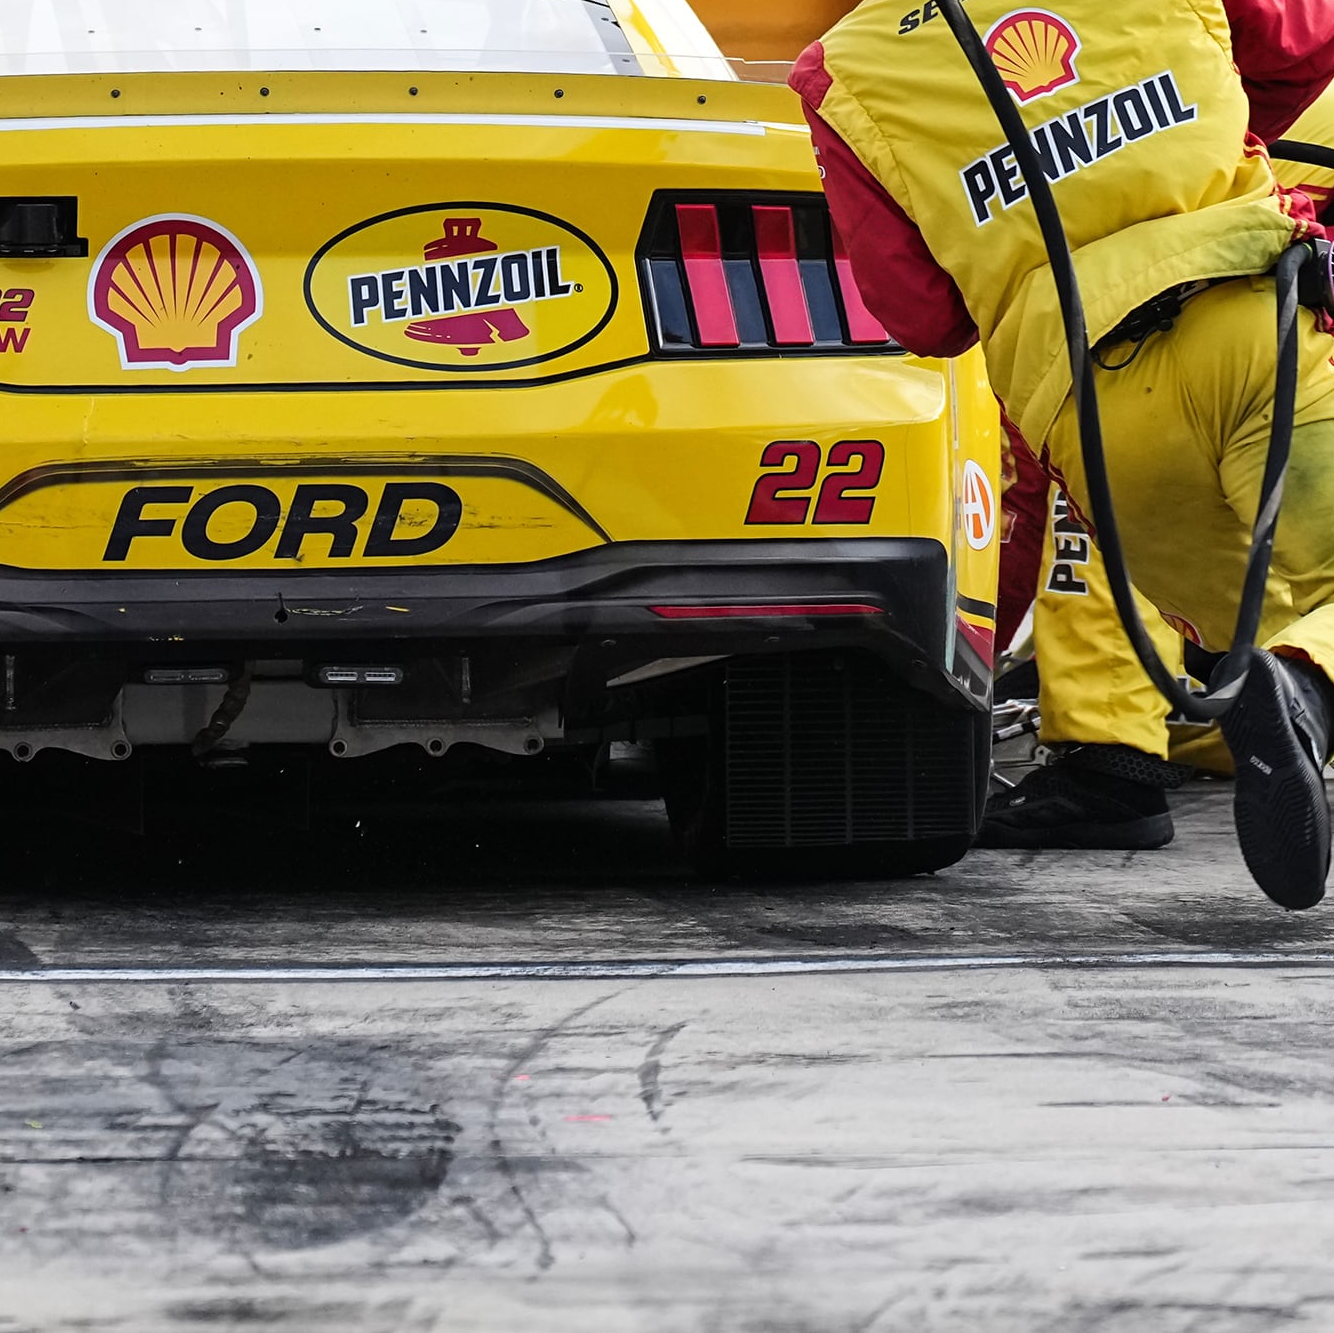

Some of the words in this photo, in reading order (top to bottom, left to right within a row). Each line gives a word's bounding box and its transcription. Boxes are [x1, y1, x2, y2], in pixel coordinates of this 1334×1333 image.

[964, 72, 1196, 225] PENNZOIL
[351, 248, 572, 325] PENNZOIL
[103, 482, 463, 561] FORD
[744, 440, 885, 525] 22
